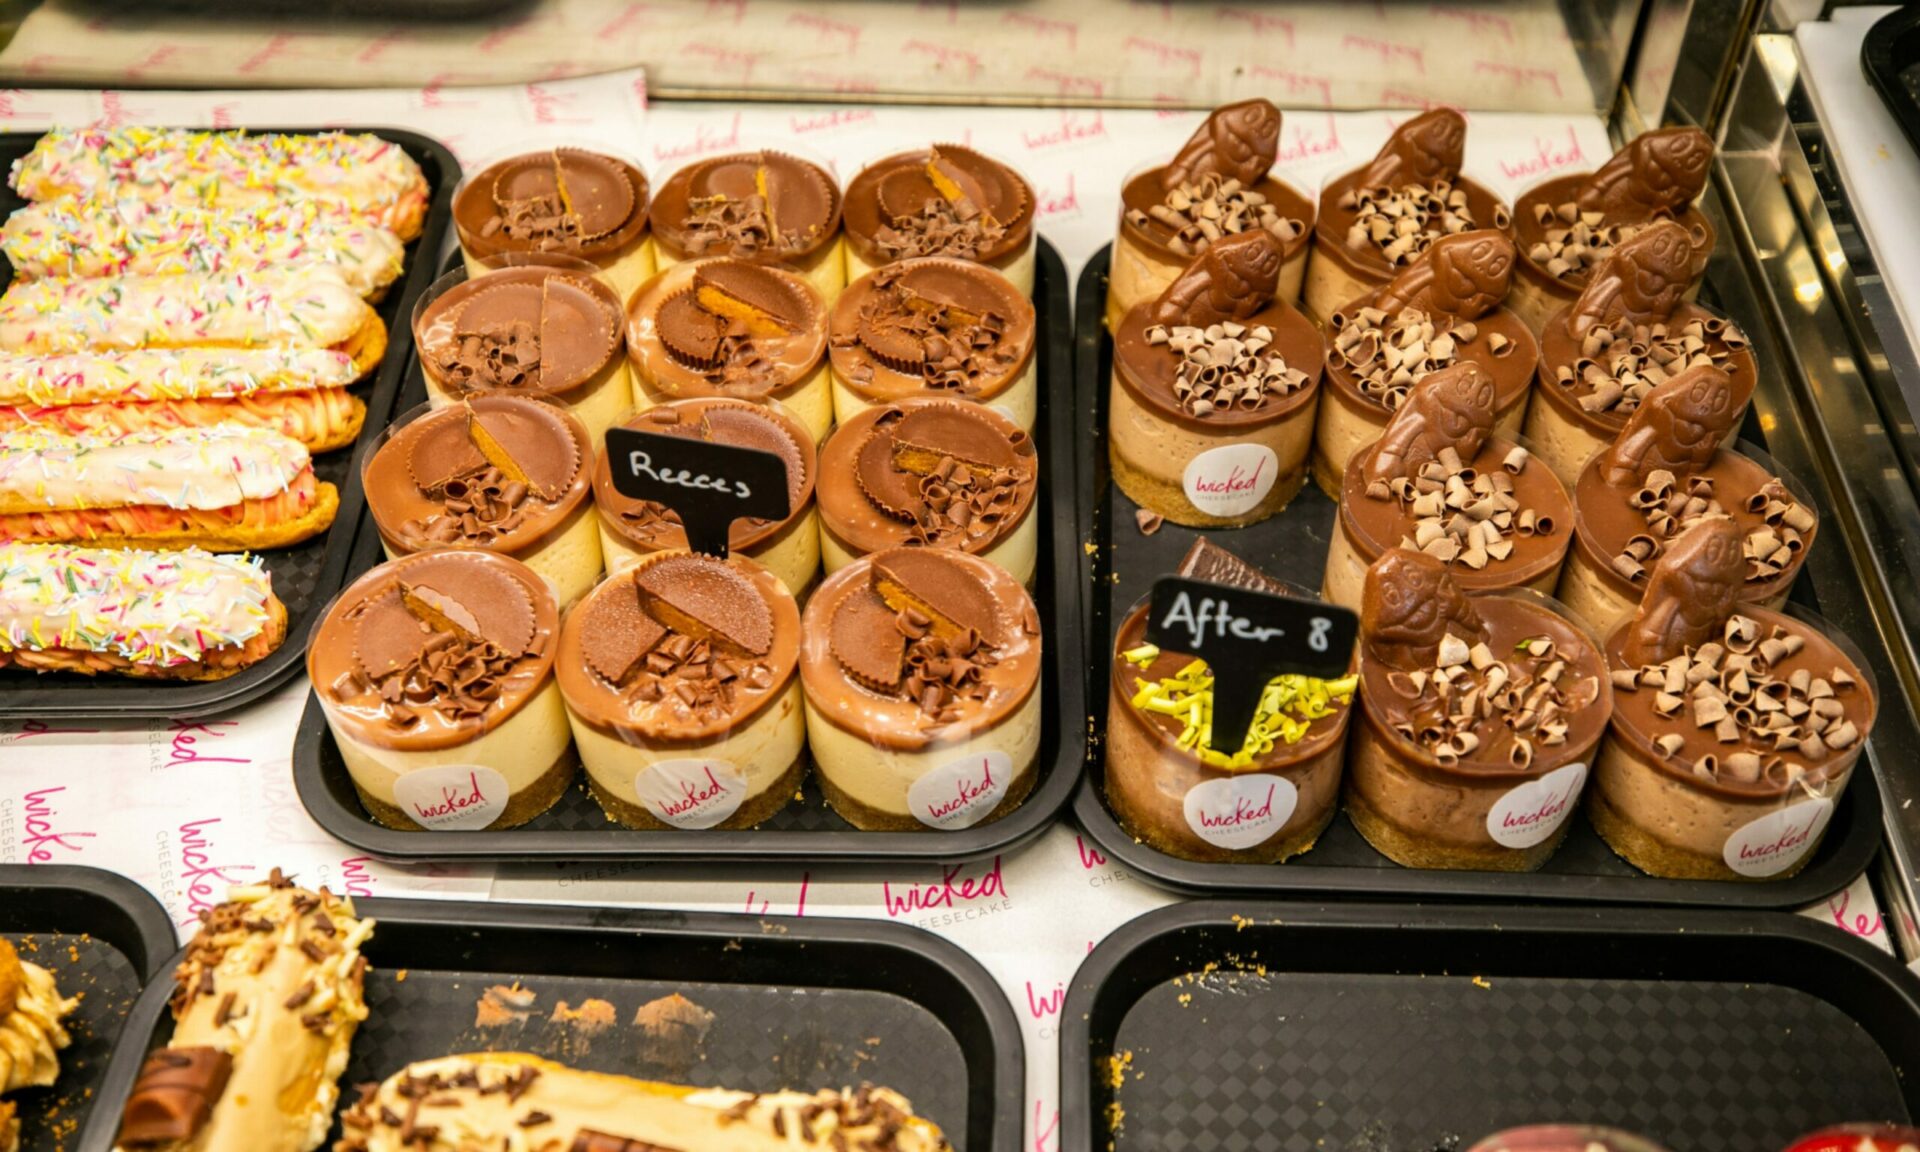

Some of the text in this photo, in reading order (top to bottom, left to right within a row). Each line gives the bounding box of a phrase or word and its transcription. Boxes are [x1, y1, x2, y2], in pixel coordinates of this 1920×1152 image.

[1195, 455, 1266, 493] wicked
[1160, 590, 1333, 653] After 8
[413, 771, 487, 818] wicked
[657, 765, 729, 817] wicked
[928, 757, 995, 818] wicked
[1200, 783, 1276, 828] wicked
[1503, 771, 1581, 828] wicked
[1, 797, 16, 864] CHEESEC
[21, 785, 98, 865] wicke
[1739, 805, 1824, 860] wicked
[884, 855, 1009, 918] wicked
[911, 899, 1013, 931] EESECAKE
